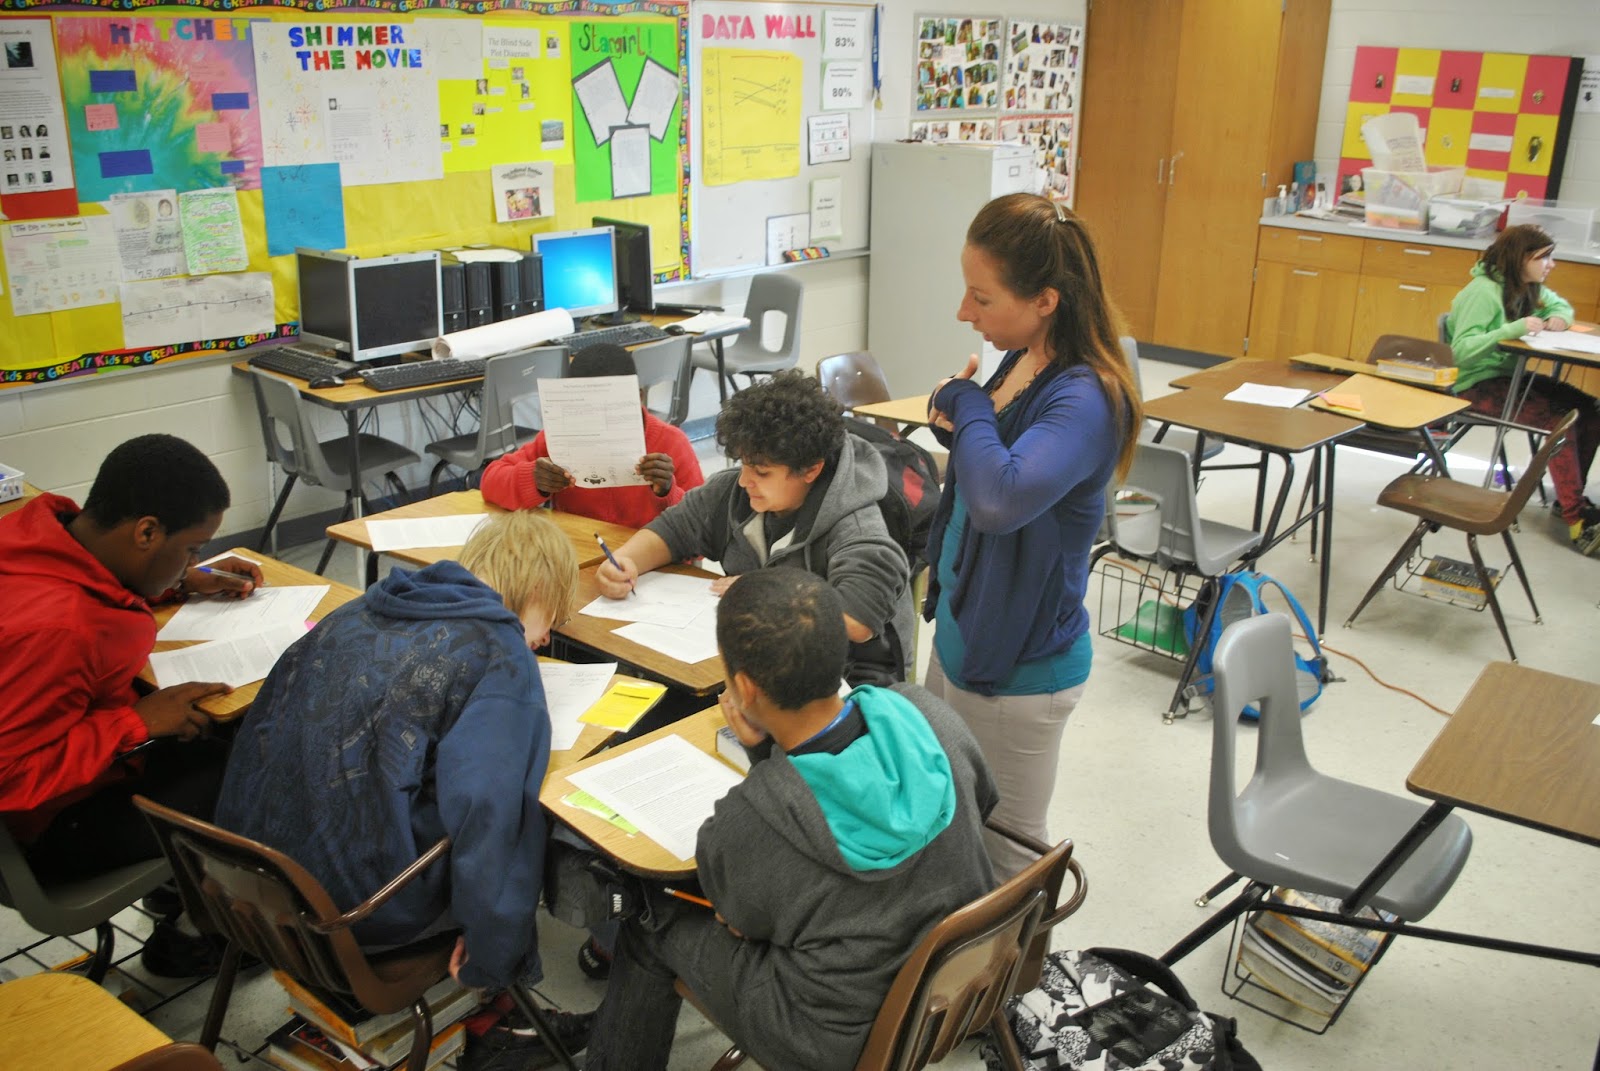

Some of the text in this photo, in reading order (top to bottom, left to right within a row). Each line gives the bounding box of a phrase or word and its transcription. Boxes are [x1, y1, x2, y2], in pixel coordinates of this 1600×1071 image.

[298, 0, 313, 10] are
[382, 2, 397, 11] are
[461, 2, 475, 11] are
[109, 19, 250, 44] HATCHET
[288, 25, 405, 47] SHIMMER
[701, 14, 816, 40] DATA WALL
[835, 37, 855, 47] 83%
[296, 48, 422, 71] THE MOVIE
[832, 87, 852, 97] 80%
[25, 371, 45, 380] are
[47, 357, 92, 379] GREAT!
[94, 355, 120, 367] Kids
[123, 355, 140, 364] are
[143, 342, 184, 362] GREAT!
[193, 340, 216, 350] Kids
[237, 332, 276, 347] GREAT!
[282, 325, 299, 336] Kid
